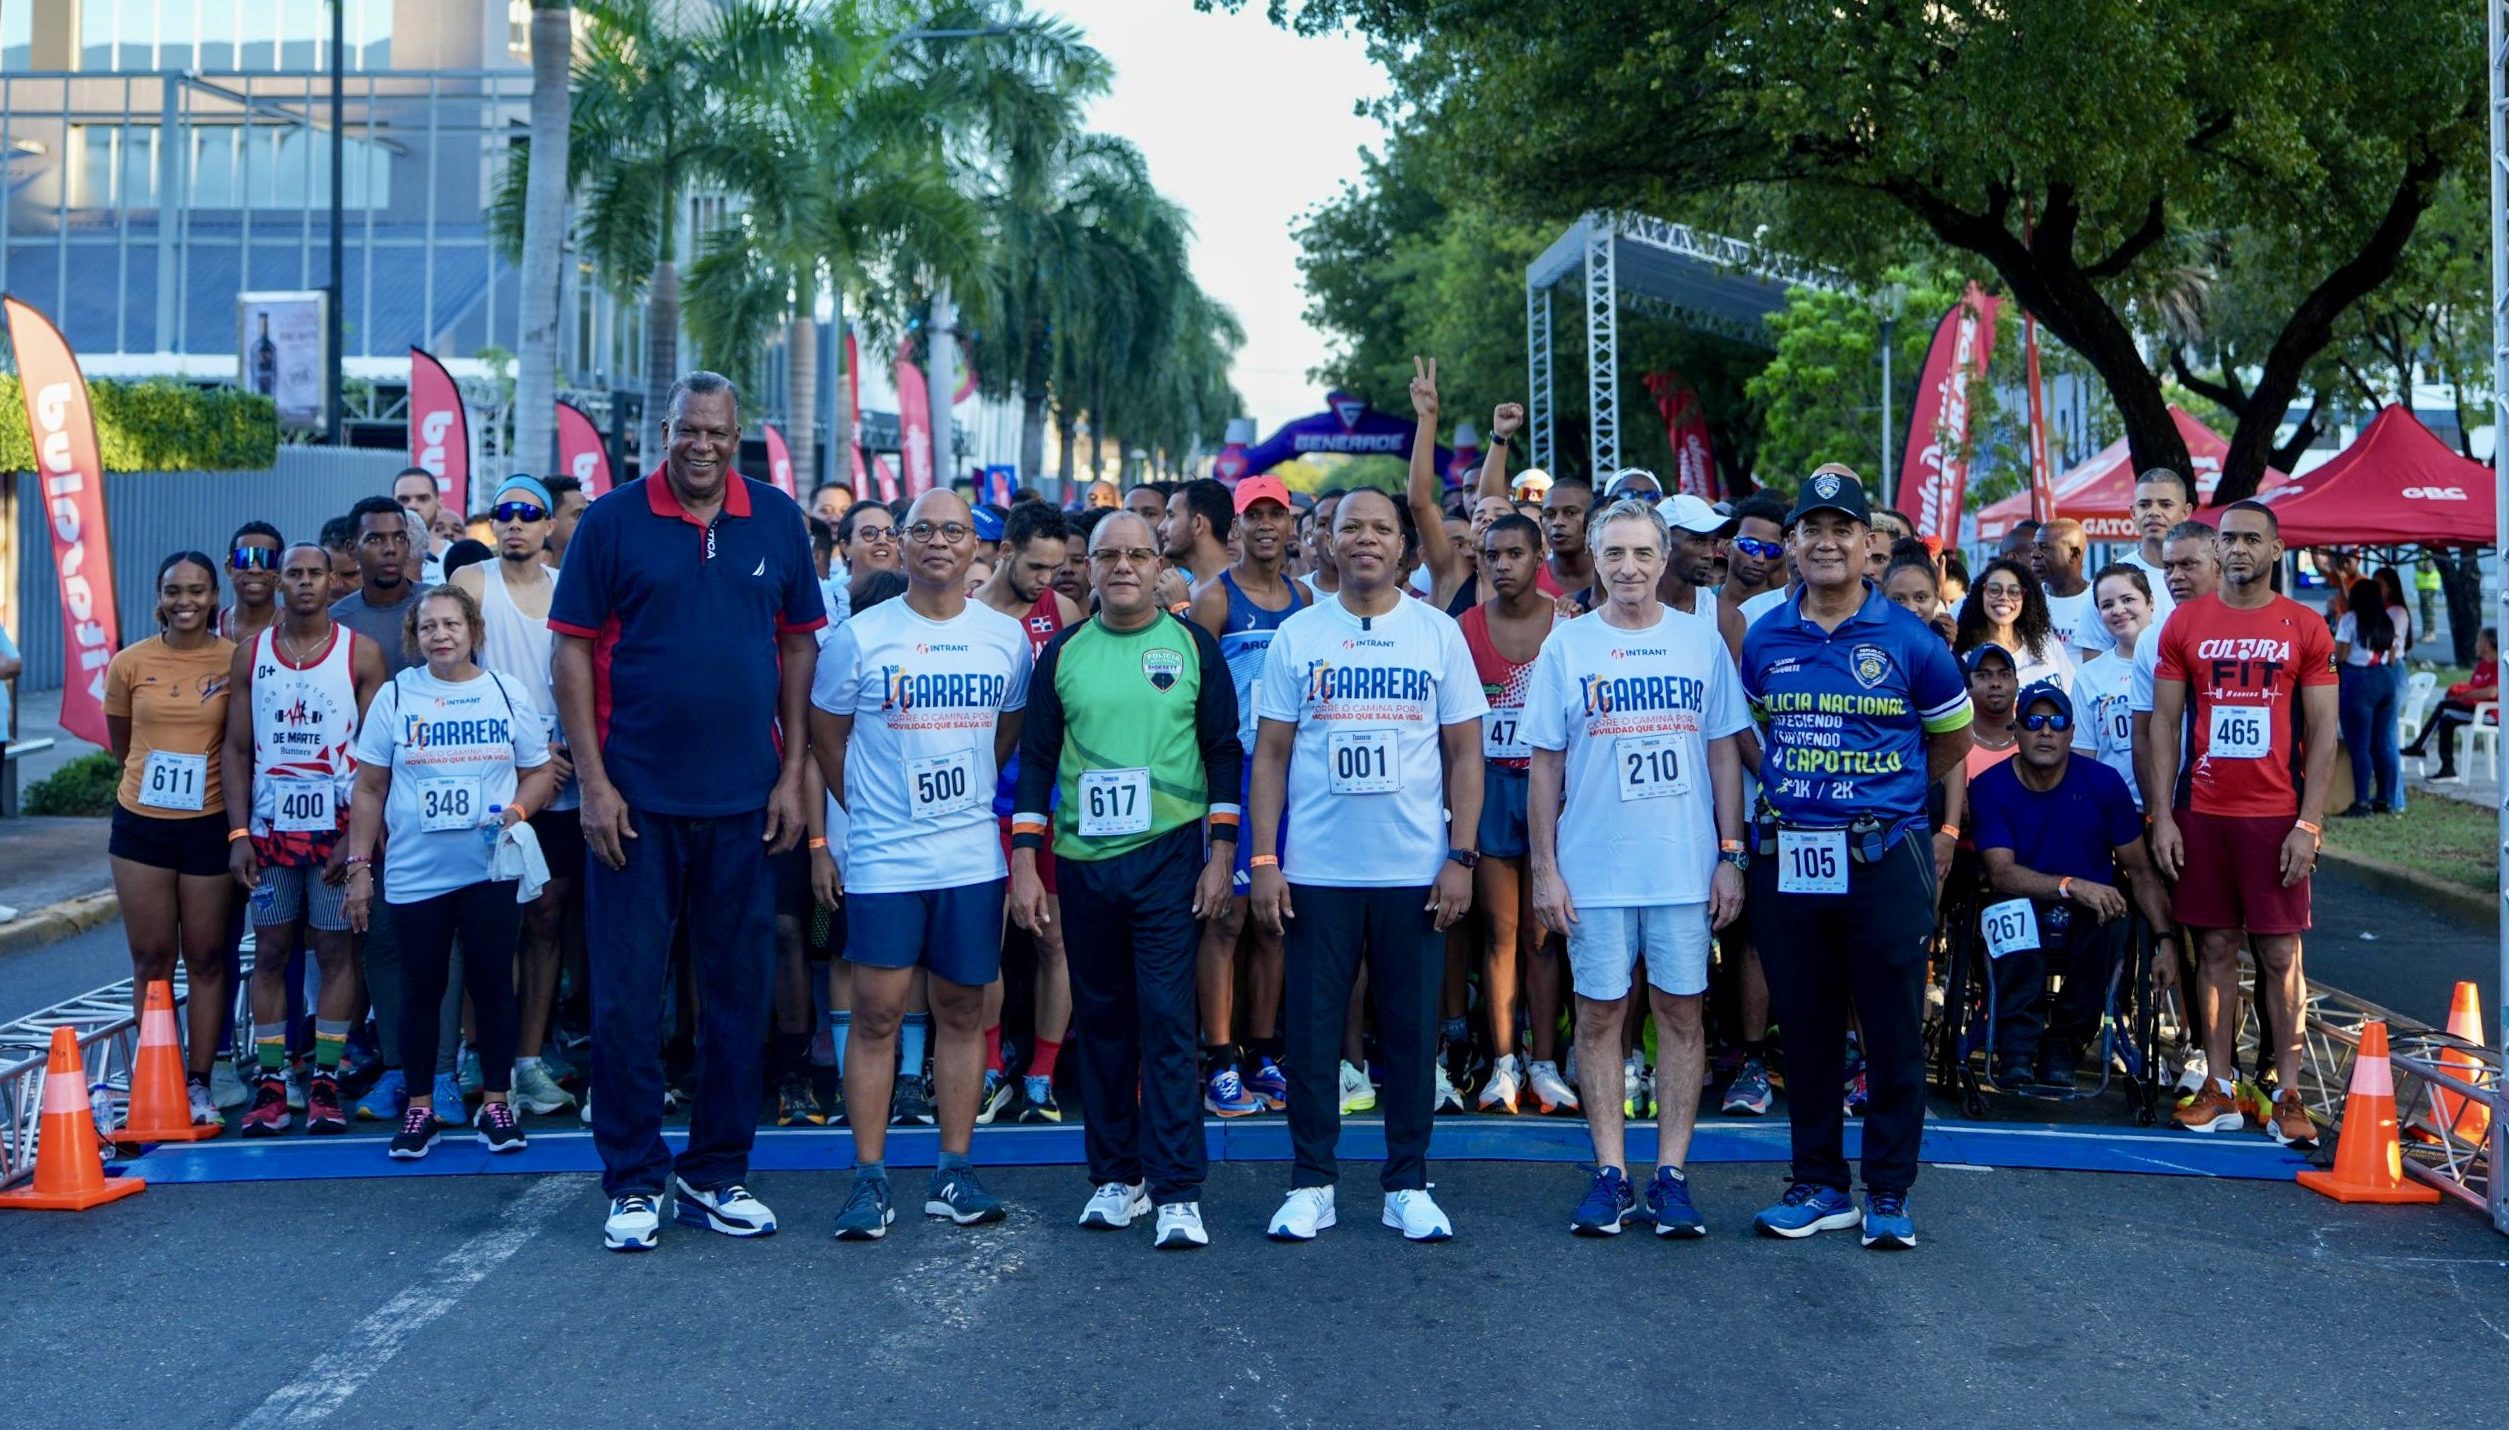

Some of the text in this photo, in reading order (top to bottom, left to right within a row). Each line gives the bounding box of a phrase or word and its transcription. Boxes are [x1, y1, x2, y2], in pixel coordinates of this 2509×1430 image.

[2082, 518, 2140, 535] GATO
[930, 644, 969, 652] INTRANT
[1356, 639, 1395, 648] INTRANT
[2198, 639, 2291, 662] CULTURA
[1321, 666, 1432, 702] CARRERA
[2212, 660, 2284, 688] FIT
[446, 697, 481, 706] INTRANT
[899, 673, 1005, 709] CARRERA
[1596, 675, 1704, 714] CARRERA
[1818, 692, 1907, 716] NACIONAL
[887, 713, 919, 723] CORRE
[931, 712, 970, 721] CAMINA
[1352, 704, 1393, 712] CAMINA
[1396, 704, 1416, 713] POR
[1632, 714, 1674, 725] CAMINA
[273, 732, 321, 744] DE MARTE
[418, 718, 511, 748] CARRERA
[887, 722, 933, 730] MOVILIDAD
[934, 722, 951, 730] QUE
[1589, 725, 1634, 737] MVILIDAD
[1635, 725, 1655, 733] QUE
[2217, 718, 2260, 745] 465
[449, 755, 467, 764] QUE
[468, 753, 494, 761] SALVA
[1337, 744, 1386, 779] 001
[1627, 749, 1679, 785] 210
[1785, 747, 1903, 774] CAPOTILLO
[152, 765, 194, 795] 611
[918, 766, 966, 804] 500
[1831, 780, 1854, 799] 2K
[282, 792, 325, 819] 400
[425, 788, 470, 818] 348
[1089, 784, 1137, 818] 617
[1790, 847, 1836, 879] 105
[1987, 911, 2025, 945] 267
